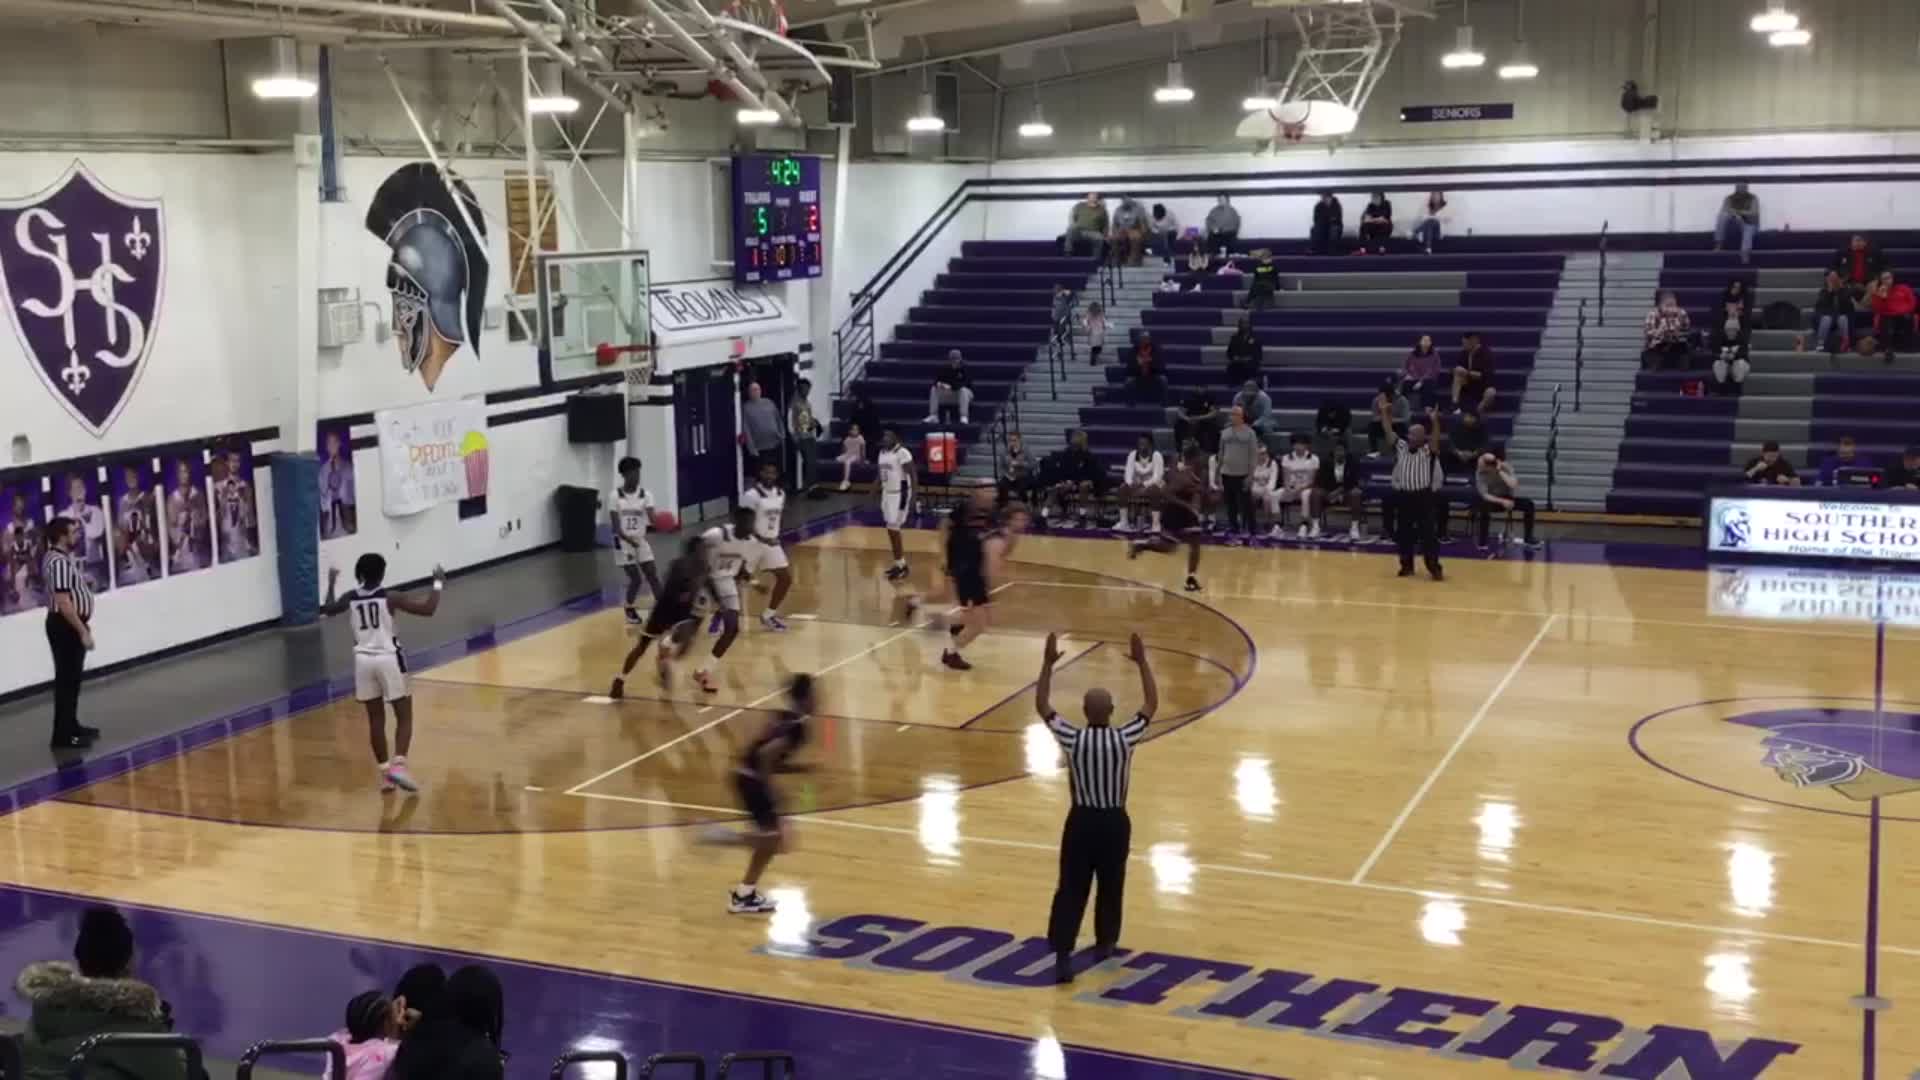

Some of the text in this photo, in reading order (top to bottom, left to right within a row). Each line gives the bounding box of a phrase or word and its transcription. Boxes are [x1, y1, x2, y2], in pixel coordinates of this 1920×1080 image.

[1432, 108, 1481, 120] SENIORS
[771, 159, 800, 186] 4:24
[757, 207, 768, 234] 5
[650, 288, 765, 324] TROJANS
[1763, 527, 1830, 542] HIGH
[357, 601, 380, 630] 10
[808, 914, 1804, 1080] SOUTHERN
